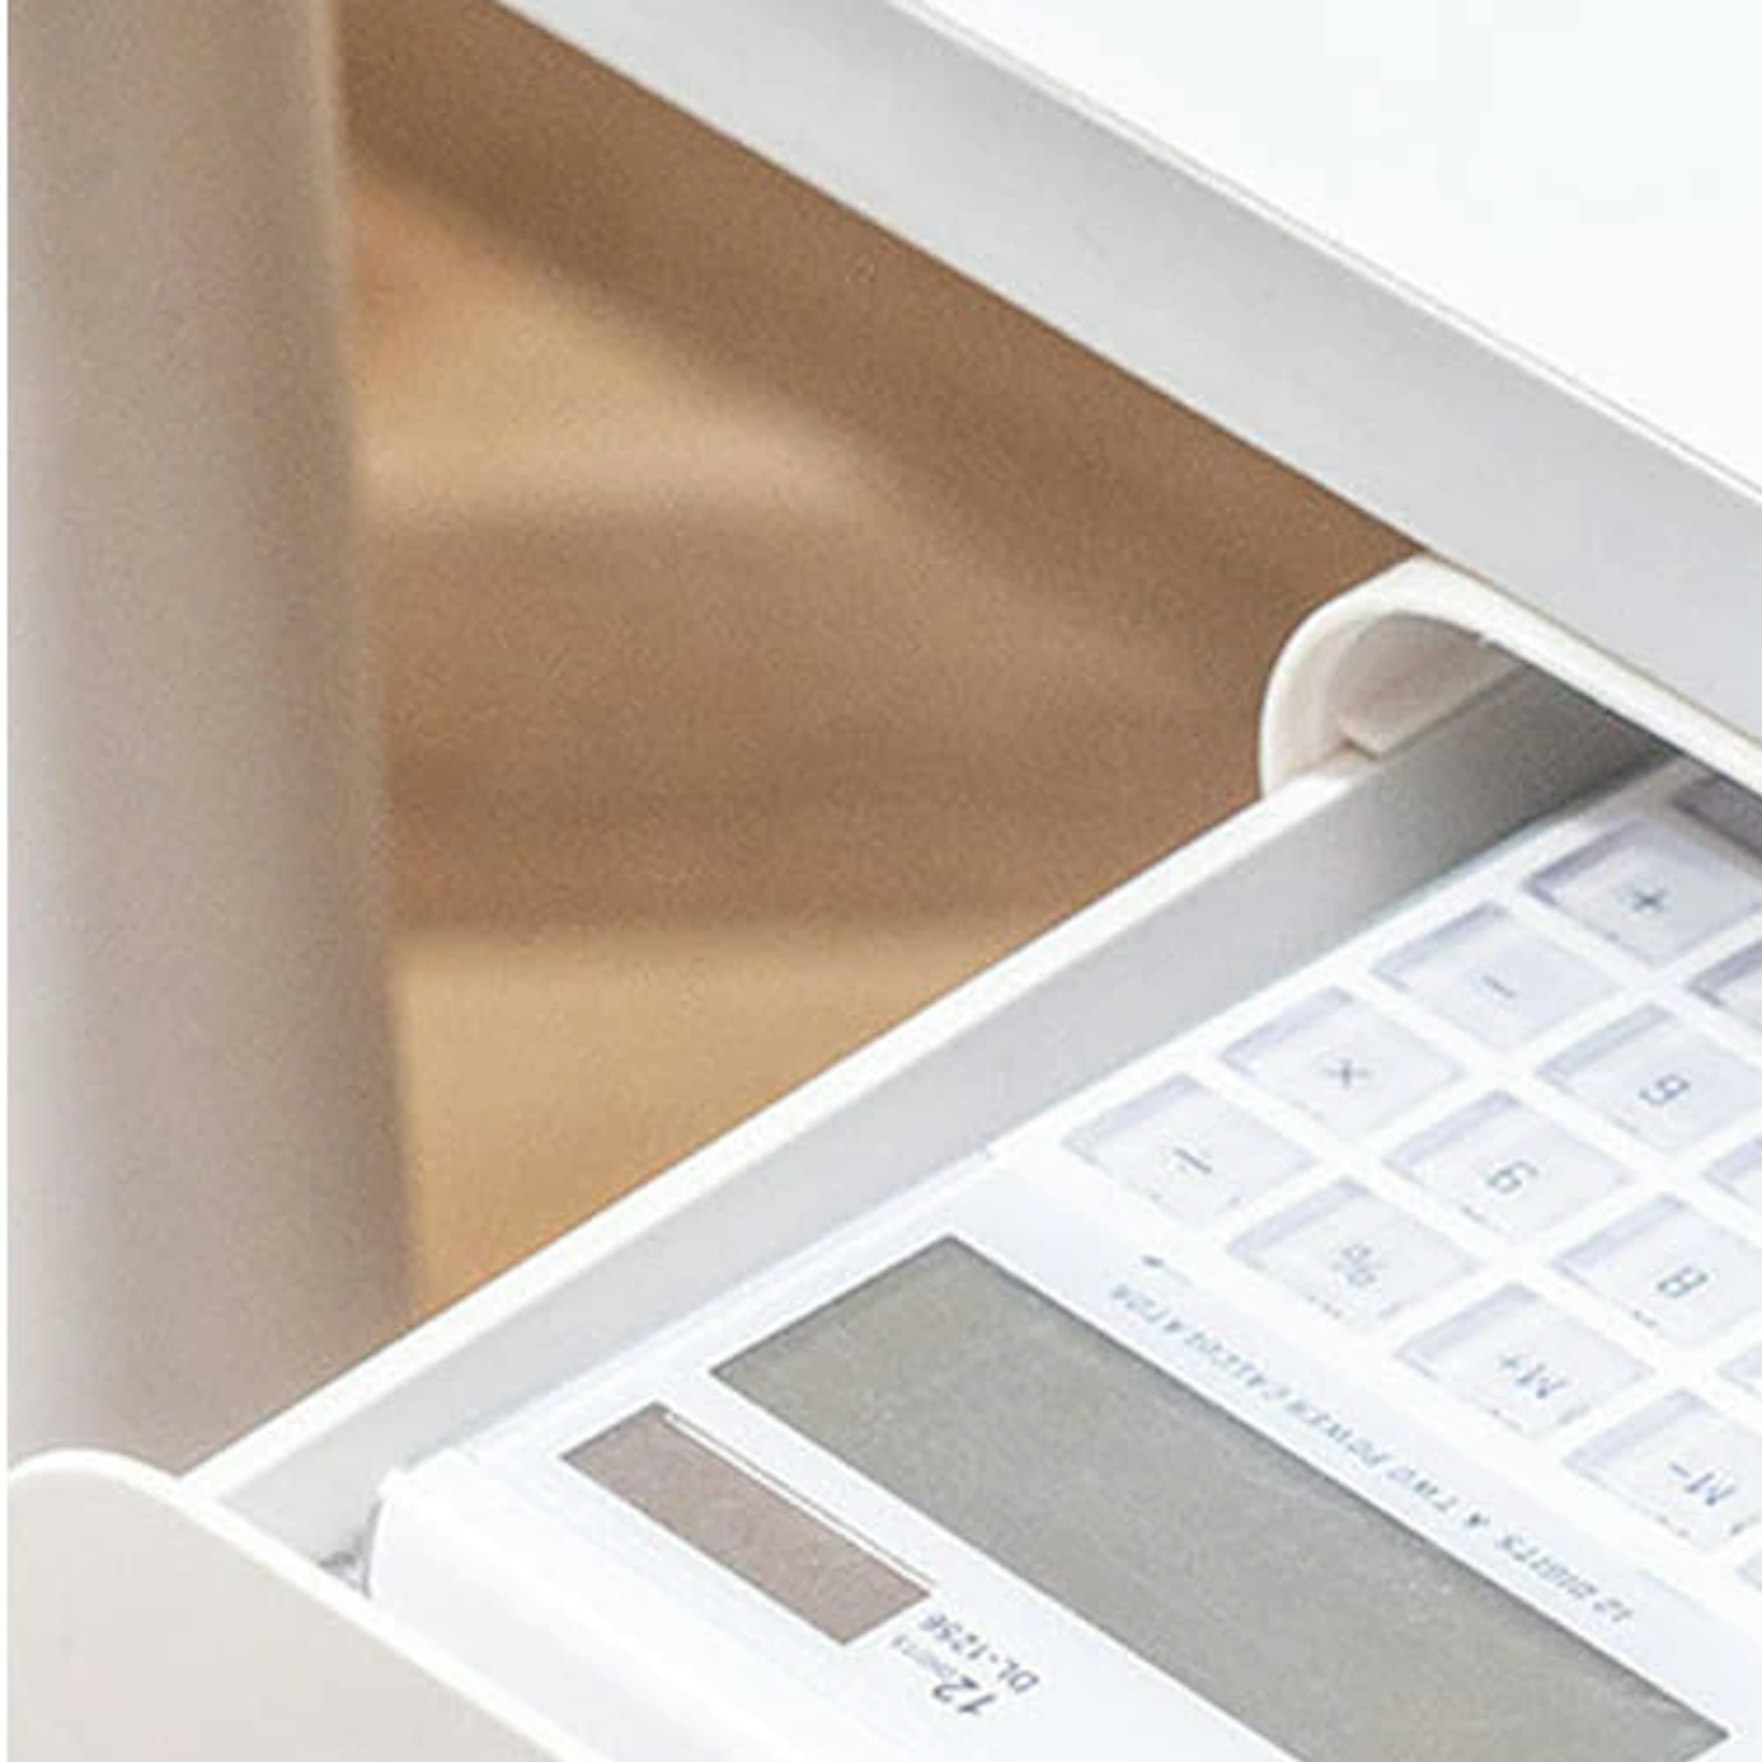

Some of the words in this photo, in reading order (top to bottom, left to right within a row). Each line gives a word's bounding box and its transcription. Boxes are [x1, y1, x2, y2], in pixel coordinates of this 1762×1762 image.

[1639, 1073, 1691, 1108] 6
[1656, 1265, 1709, 1299] 8
[932, 1674, 998, 1716] 12
